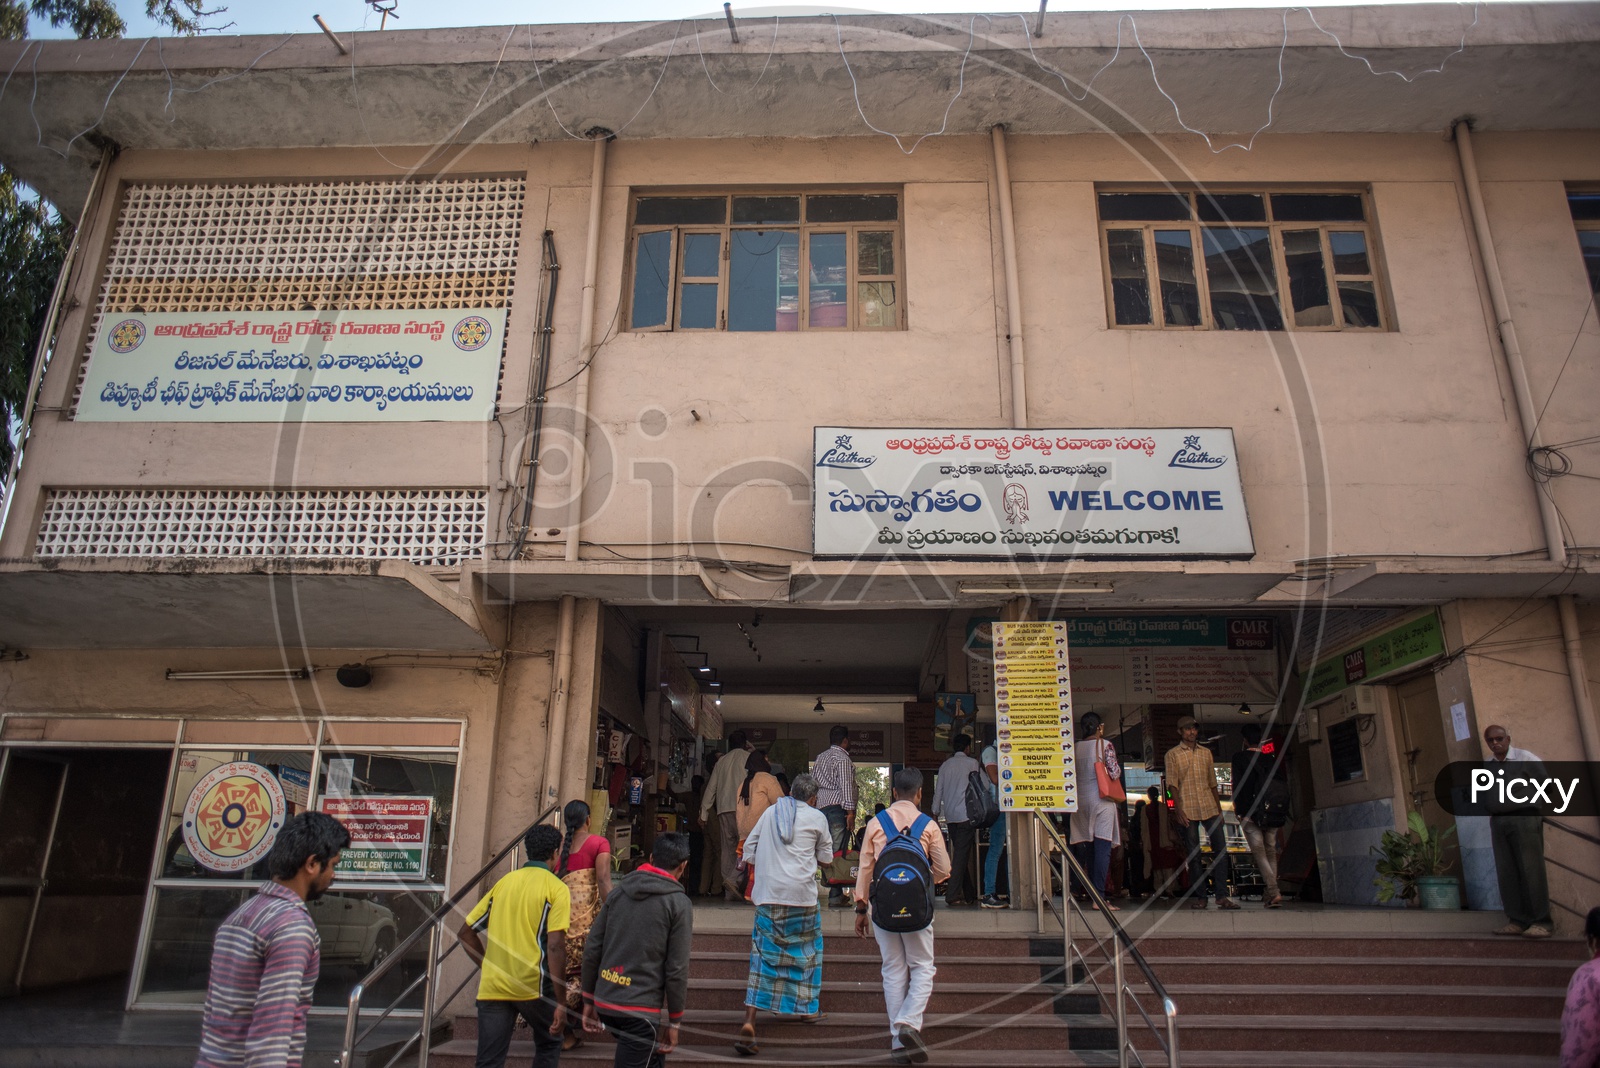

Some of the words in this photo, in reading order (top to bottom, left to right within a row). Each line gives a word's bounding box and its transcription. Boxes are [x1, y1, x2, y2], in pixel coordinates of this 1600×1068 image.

[154, 320, 251, 338] ఆంధ్రప్రదేశ్
[251, 321, 293, 343] రాష్ట్ర
[294, 319, 338, 341] రోడ్డు
[339, 321, 400, 336] రవాణా
[404, 320, 446, 341] సంస్థ
[174, 350, 237, 371] రీజనల్
[236, 349, 313, 372] మేనేజరు,
[317, 350, 423, 375] విశాఖపట్నం
[100, 379, 159, 411] డిప్యూటీ
[190, 379, 239, 409] ట్రాఫిక్
[239, 377, 306, 403] మేనేజరు
[307, 383, 342, 402] వారి
[344, 383, 474, 411] కార్యాలయములు
[886, 435, 972, 455] ఆంధ్రప్రదేశ్
[974, 436, 1012, 460] రాష్ట్ర
[1013, 435, 1053, 456] రోడ్డు
[1056, 436, 1112, 451] రవాణా
[1115, 436, 1156, 457] సంస్థ
[816, 448, 878, 470] Lalithaa
[1168, 448, 1228, 470] Lalithaa
[940, 464, 982, 478] ద్వారకా
[1039, 464, 1107, 478] విశాఖపట్నం
[828, 488, 982, 522] సుస్వాగతం
[1048, 490, 1224, 511] WELCOME
[878, 529, 903, 544] మీ
[907, 528, 997, 549] ప్రయాణం
[1230, 620, 1271, 634] CMR
[1345, 650, 1364, 669] CMR
[370, 851, 409, 859] CORRUPTION
[393, 861, 404, 869] NO.
[601, 969, 632, 987] abibas
